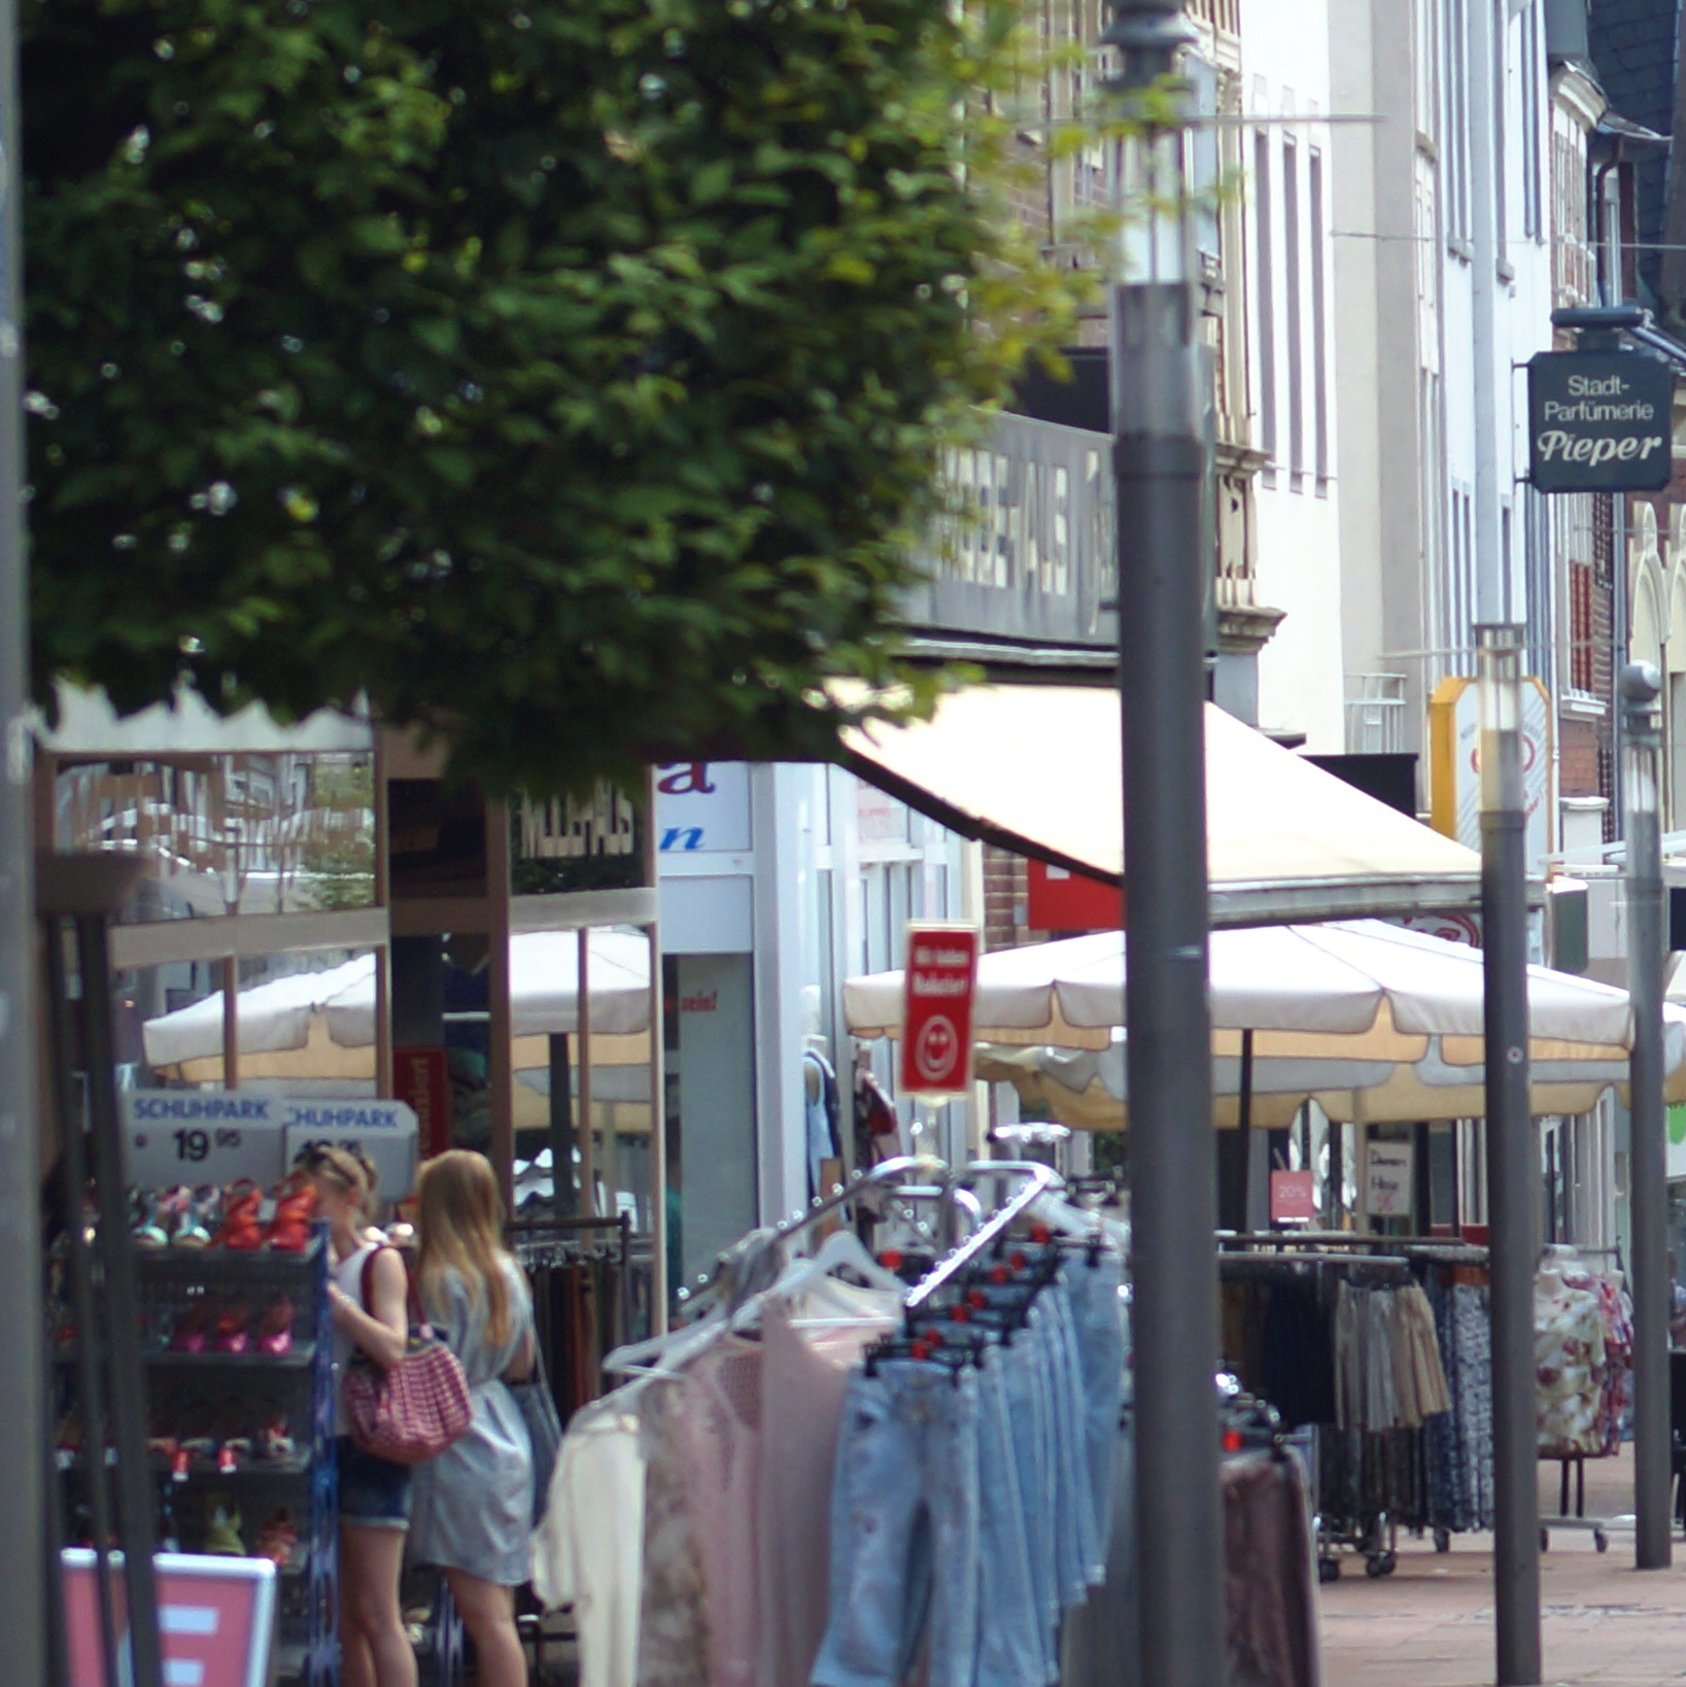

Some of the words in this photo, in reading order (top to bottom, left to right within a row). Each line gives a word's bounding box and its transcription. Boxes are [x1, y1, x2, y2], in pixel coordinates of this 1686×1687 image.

[1567, 374, 1631, 396] Stadt-
[1543, 400, 1655, 422] Parfümerie
[1536, 430, 1663, 467] Pieper
[133, 1098, 270, 1120] SCHUHPARK
[172, 1129, 209, 1162] 19
